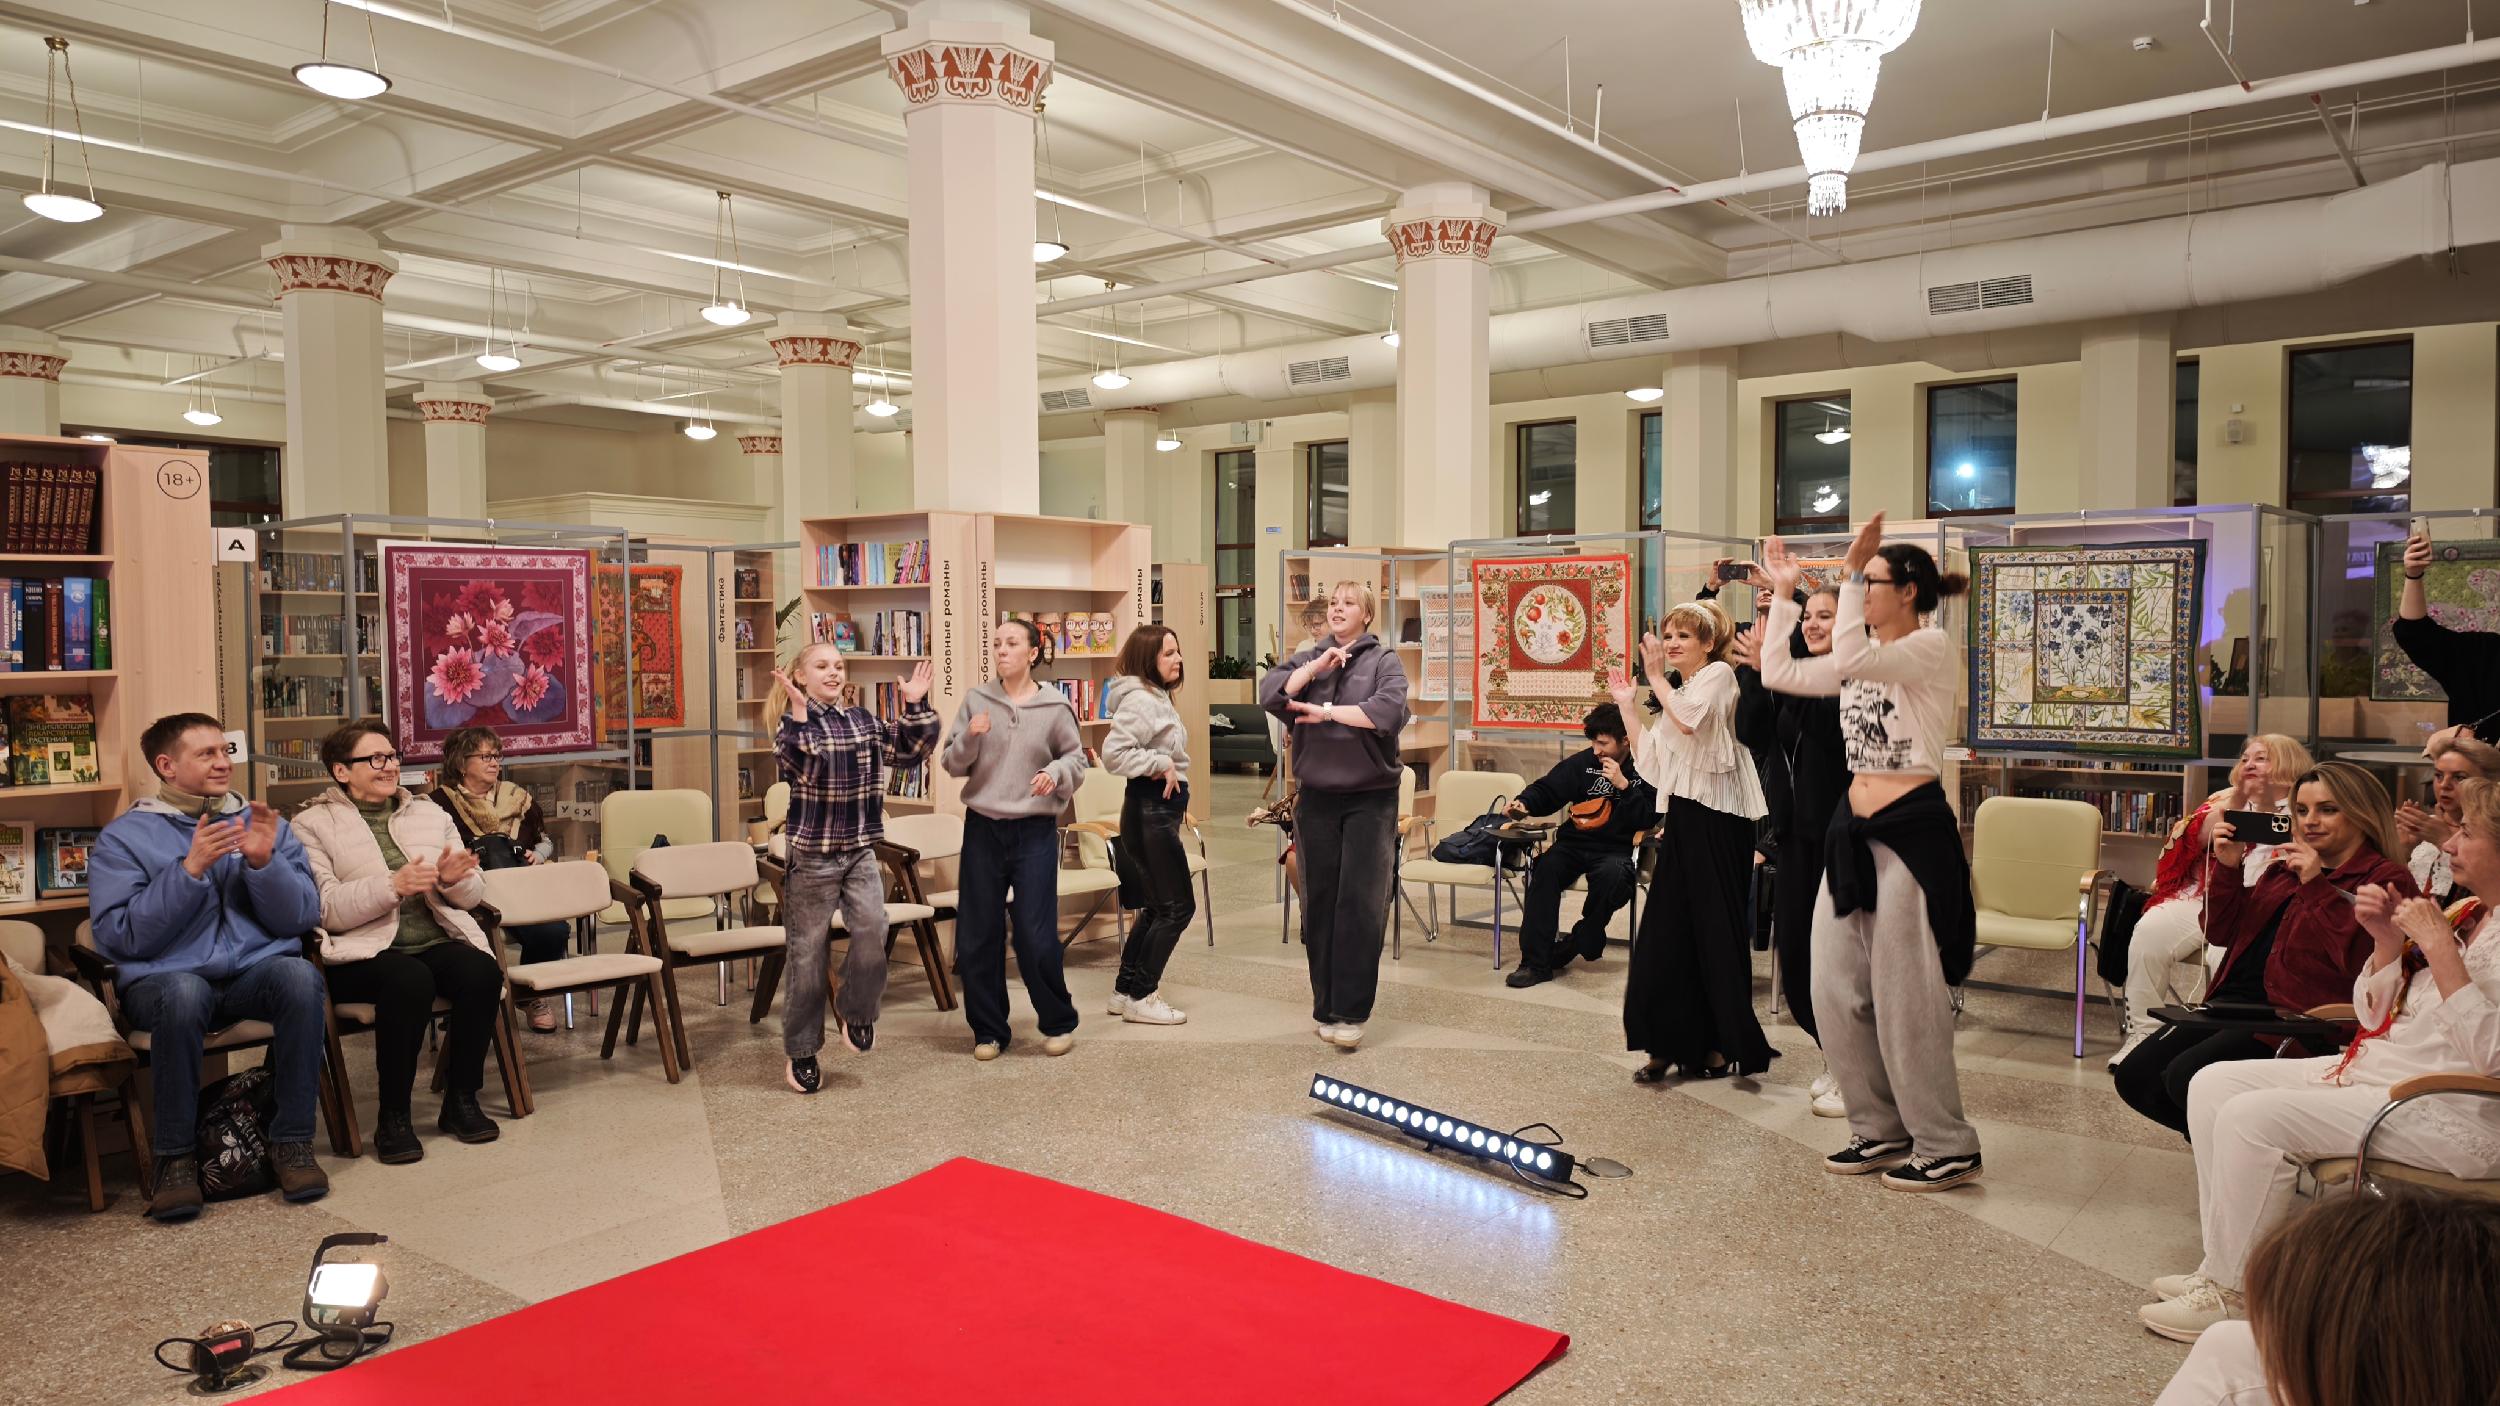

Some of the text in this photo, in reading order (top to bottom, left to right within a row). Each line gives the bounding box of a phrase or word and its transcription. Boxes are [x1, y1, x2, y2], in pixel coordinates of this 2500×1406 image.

[163, 473, 194, 486] 18+
[228, 539, 245, 551] А
[980, 561, 989, 616] романы
[943, 560, 953, 697] Любовные романы
